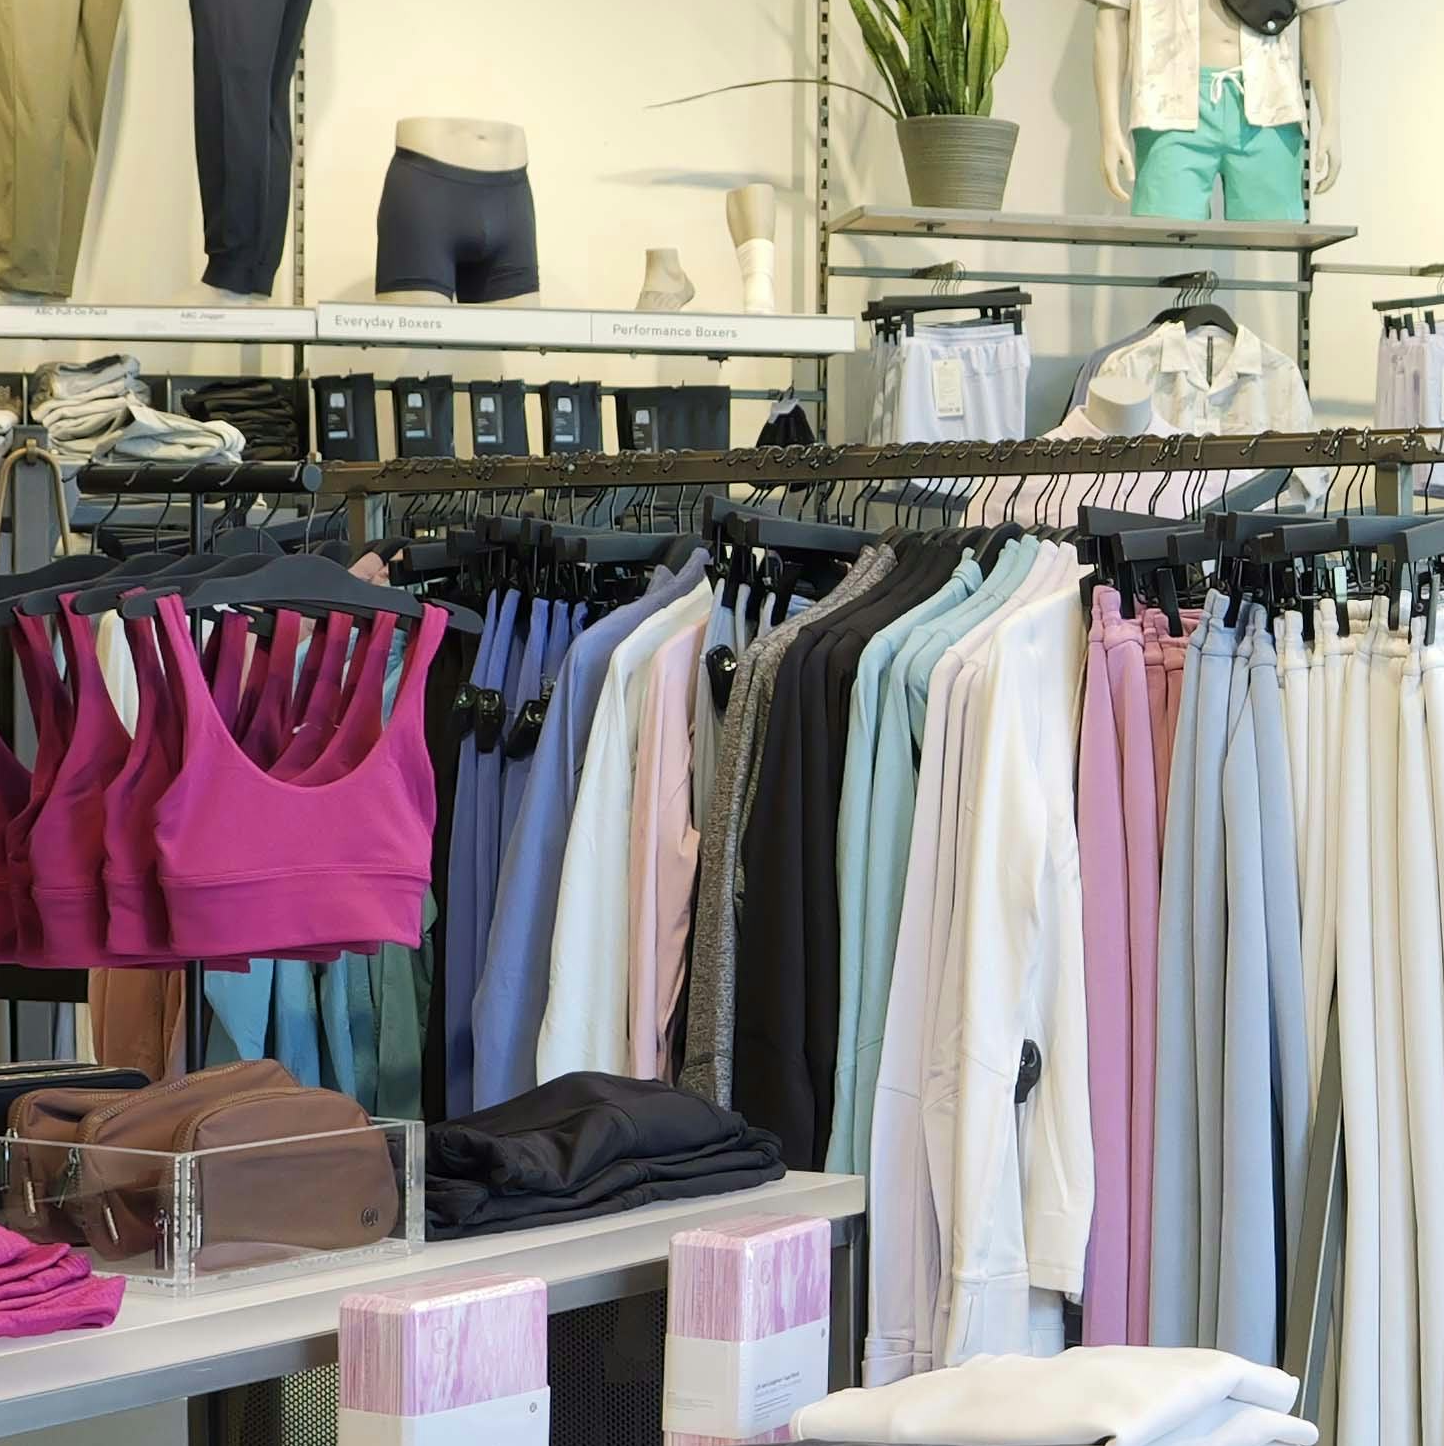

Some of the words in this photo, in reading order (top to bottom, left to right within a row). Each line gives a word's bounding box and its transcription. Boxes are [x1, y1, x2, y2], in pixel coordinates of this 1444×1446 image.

[334, 314, 394, 330] Everyday
[398, 316, 443, 329] Boxers
[612, 323, 692, 336] Performance
[695, 325, 738, 339] Boxers
